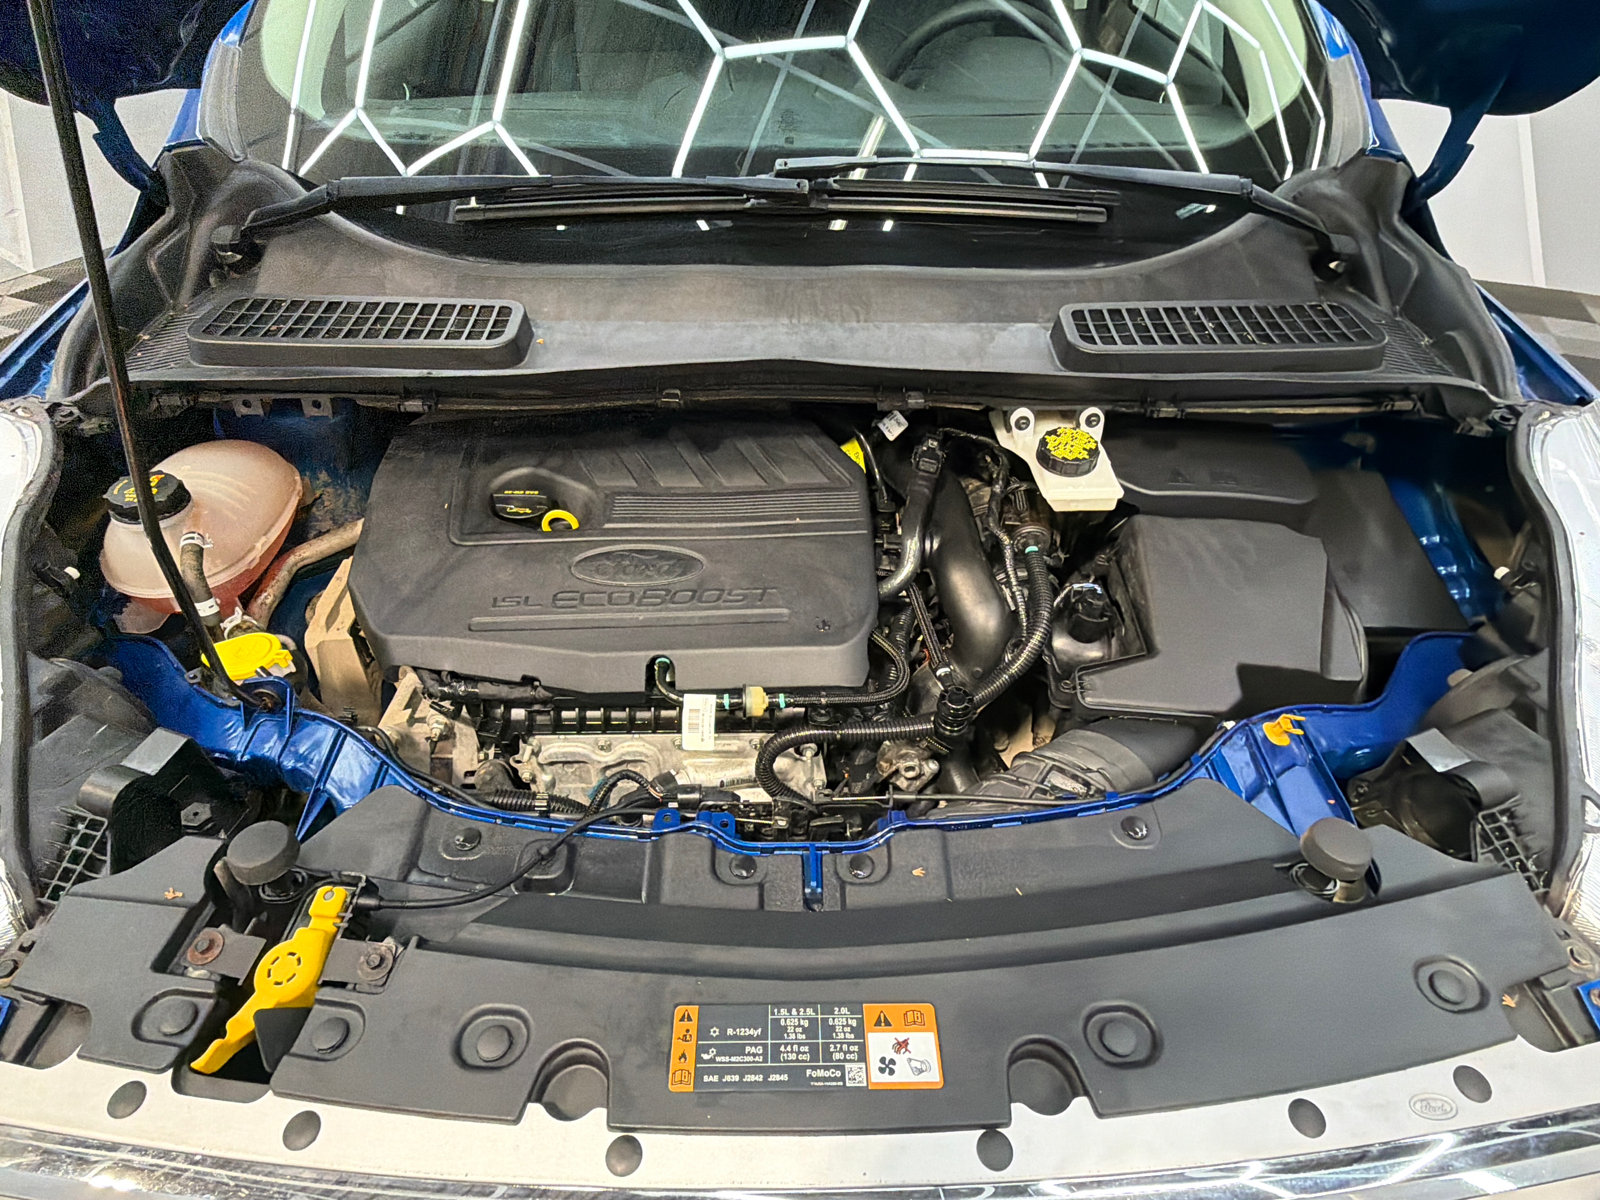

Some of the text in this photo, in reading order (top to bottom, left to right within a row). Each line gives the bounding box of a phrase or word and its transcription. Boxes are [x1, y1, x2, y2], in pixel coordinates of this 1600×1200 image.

[774, 1008, 816, 1016] 1.5L & 2.5L
[834, 1007, 850, 1015] 2.0L
[780, 1018, 809, 1027] 0.625 kg
[828, 1018, 857, 1027] 0.625 kg
[726, 1028, 762, 1037] R-1234yf
[745, 1046, 763, 1054] PAG
[779, 1044, 791, 1052] 4.4
[792, 1044, 798, 1052] fl
[829, 1044, 841, 1052] 2.7
[780, 1053, 810, 1062] (130 cc)
[832, 1052, 858, 1061] (80 cc)
[703, 1074, 719, 1082] SAE
[742, 1074, 764, 1082] J2842
[767, 1073, 789, 1081] J2845
[806, 1068, 842, 1078] FoMoCo
